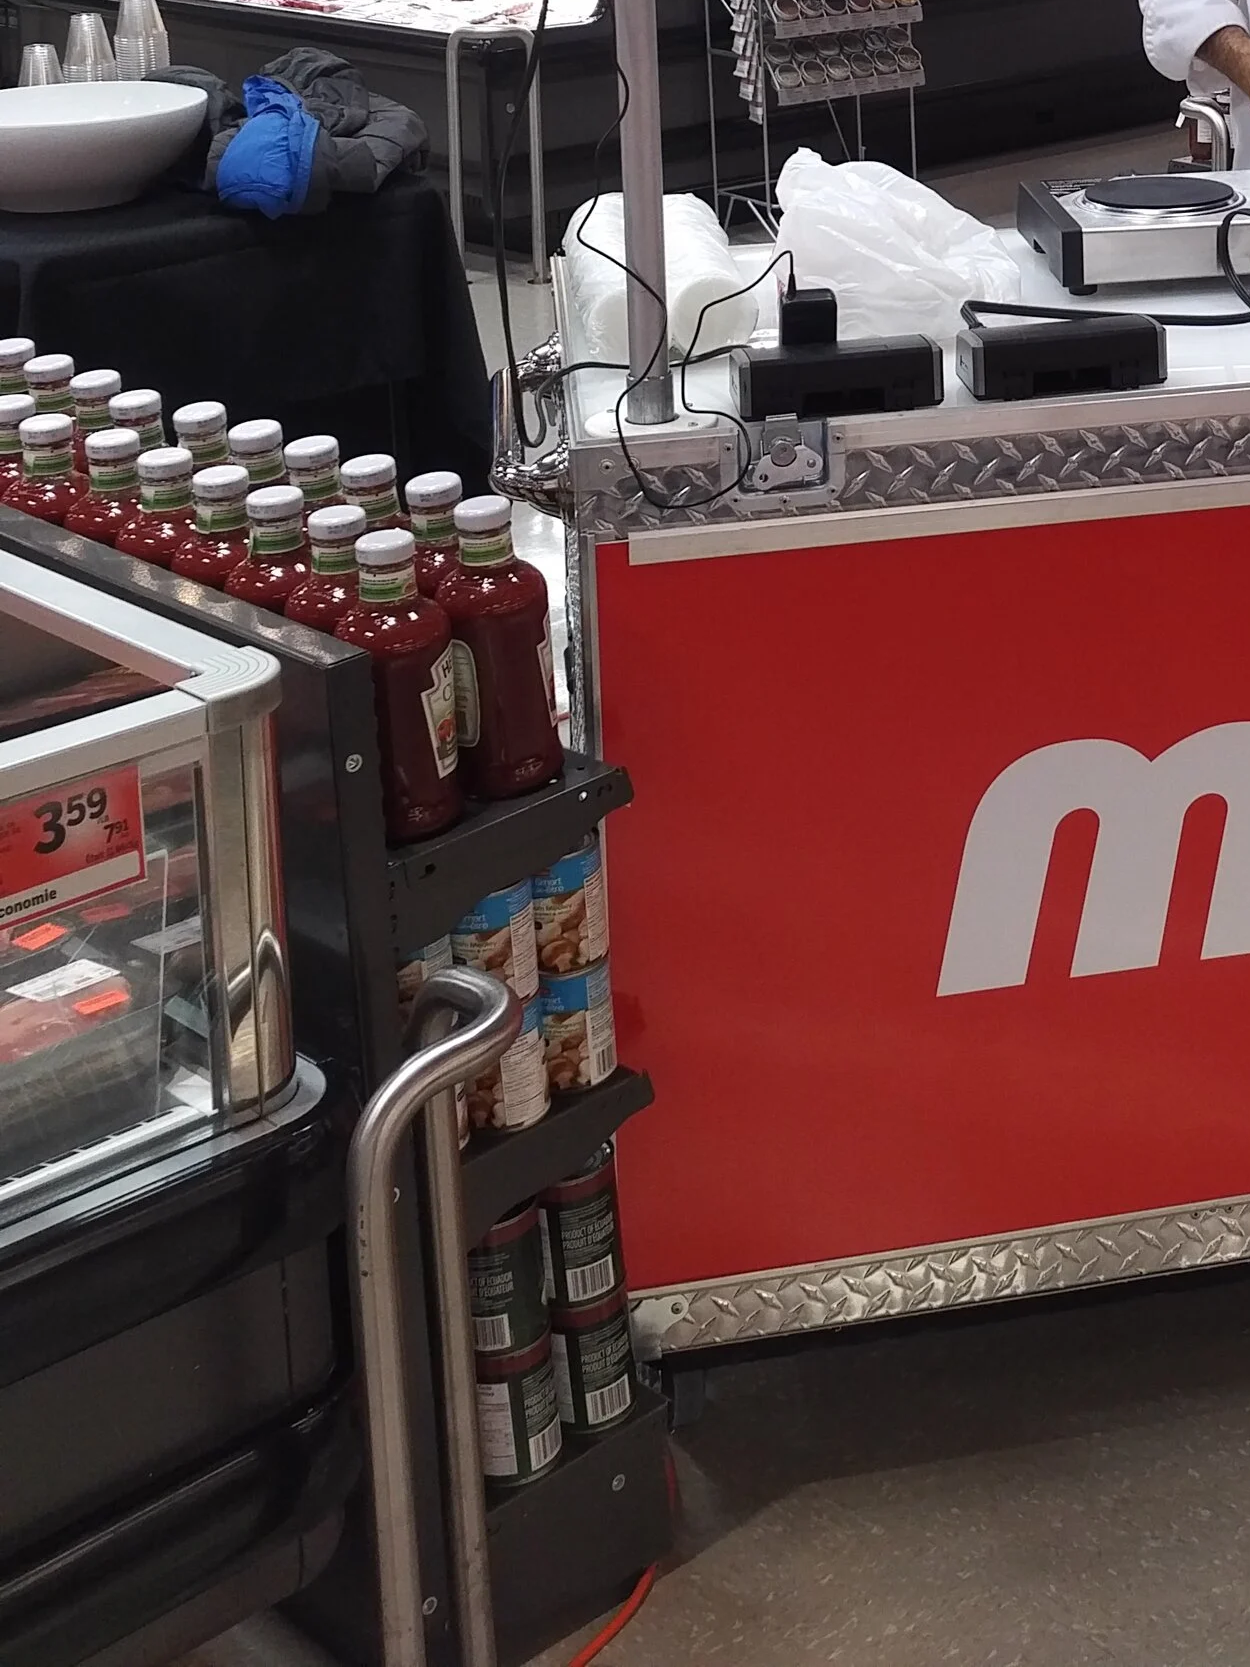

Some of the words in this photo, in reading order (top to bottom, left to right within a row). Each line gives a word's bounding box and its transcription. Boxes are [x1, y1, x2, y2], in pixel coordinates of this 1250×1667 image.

[562, 1227, 588, 1241] PRODUCT
[563, 1236, 588, 1249] PRODUIT
[581, 1348, 605, 1363] PRODUCT
